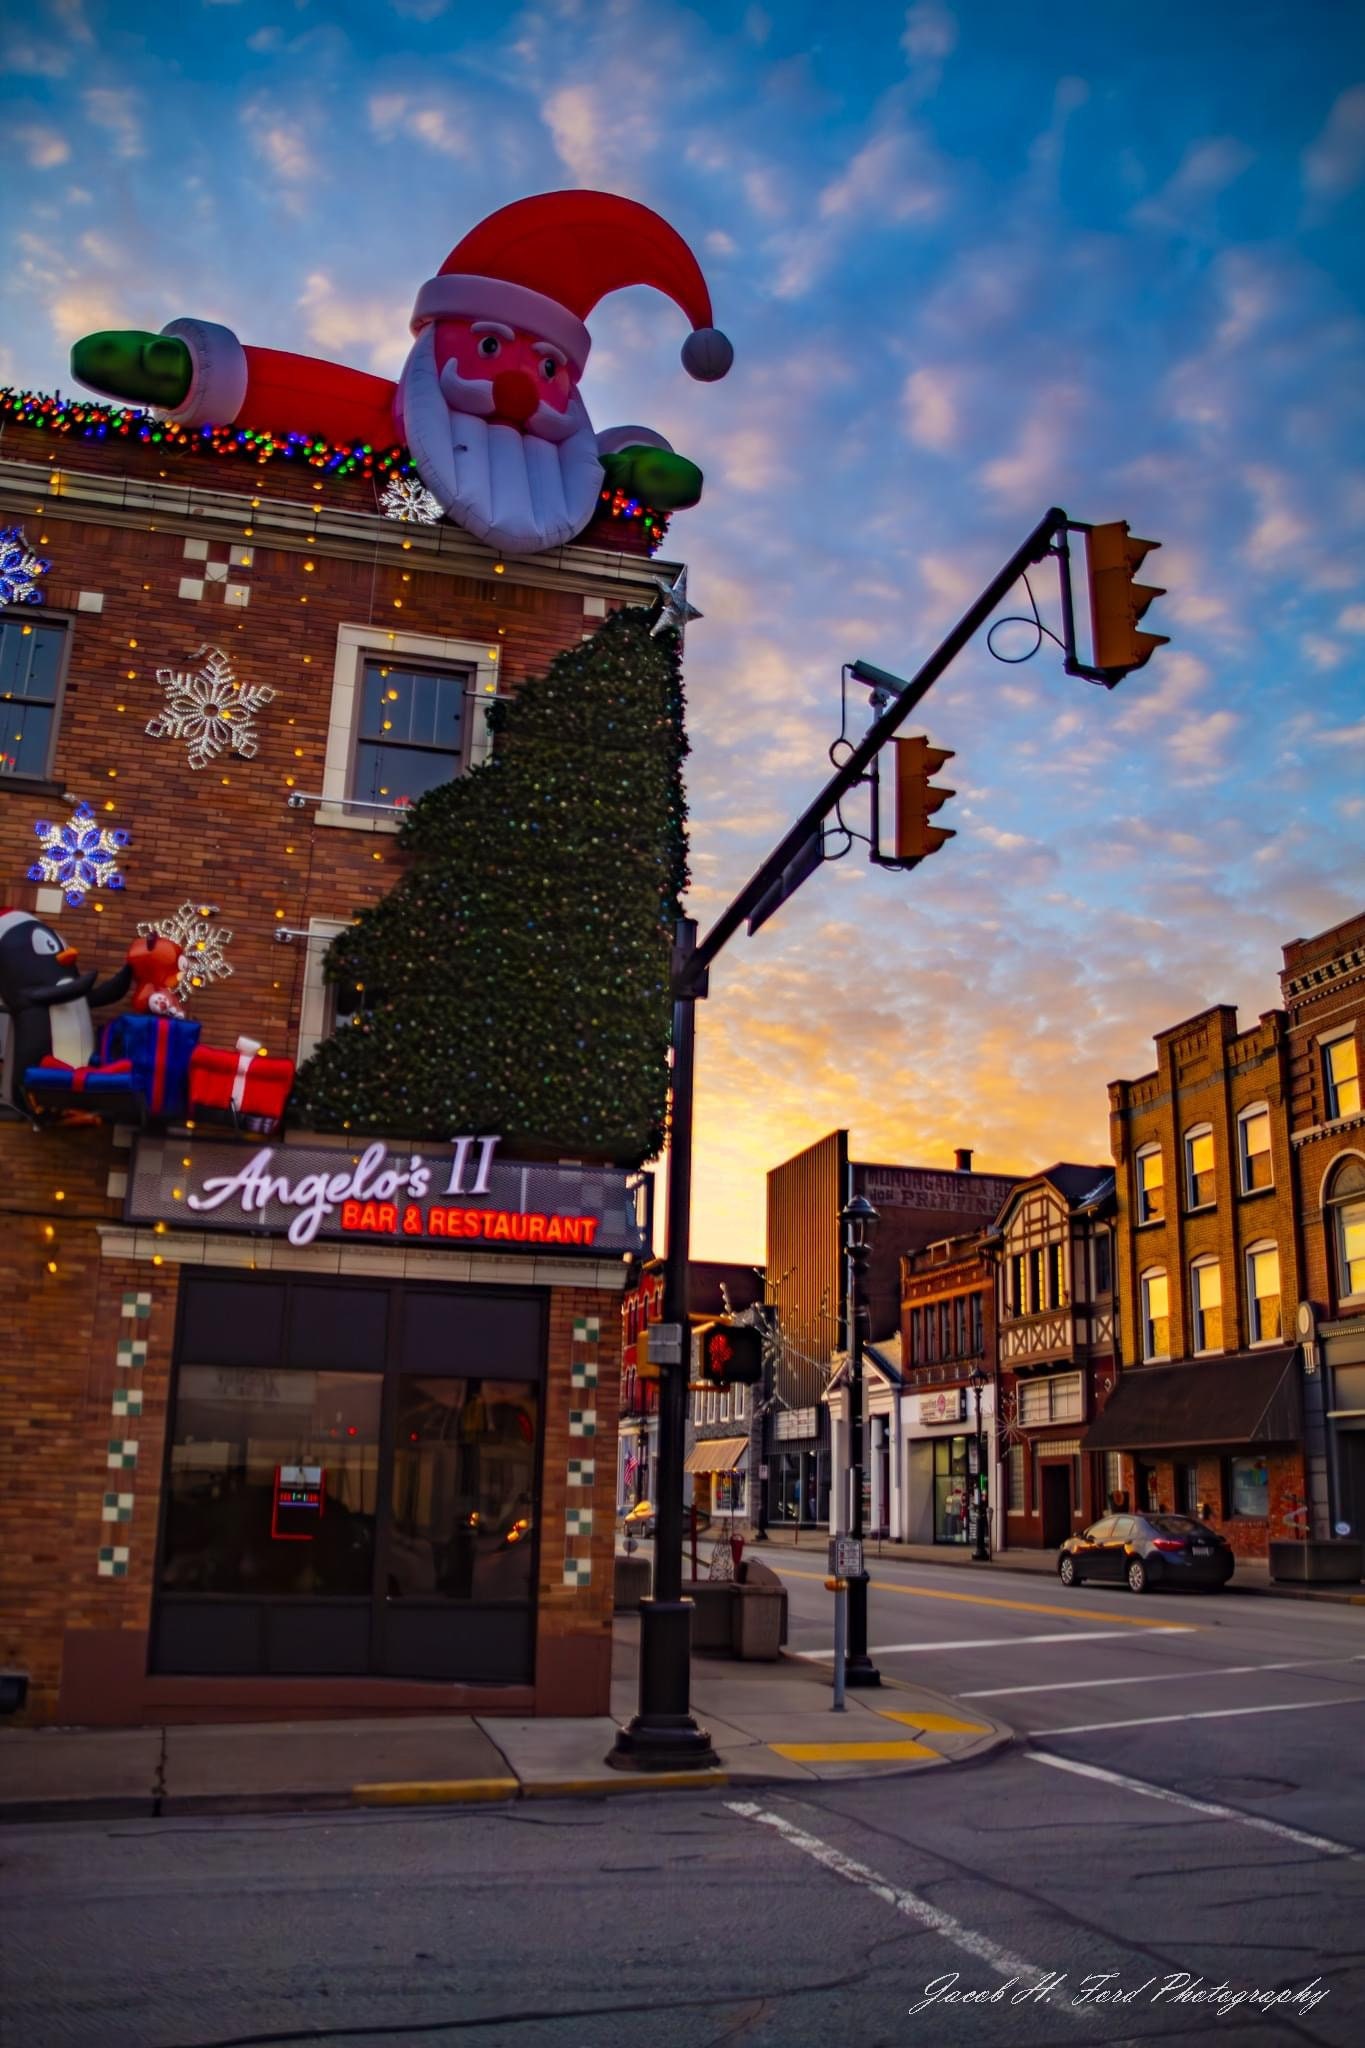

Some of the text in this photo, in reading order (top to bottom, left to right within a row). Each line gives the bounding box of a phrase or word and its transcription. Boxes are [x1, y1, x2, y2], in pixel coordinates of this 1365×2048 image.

[188, 1135, 502, 1245] Angelo's II
[342, 1200, 599, 1245] BAR & RESTAURANT
